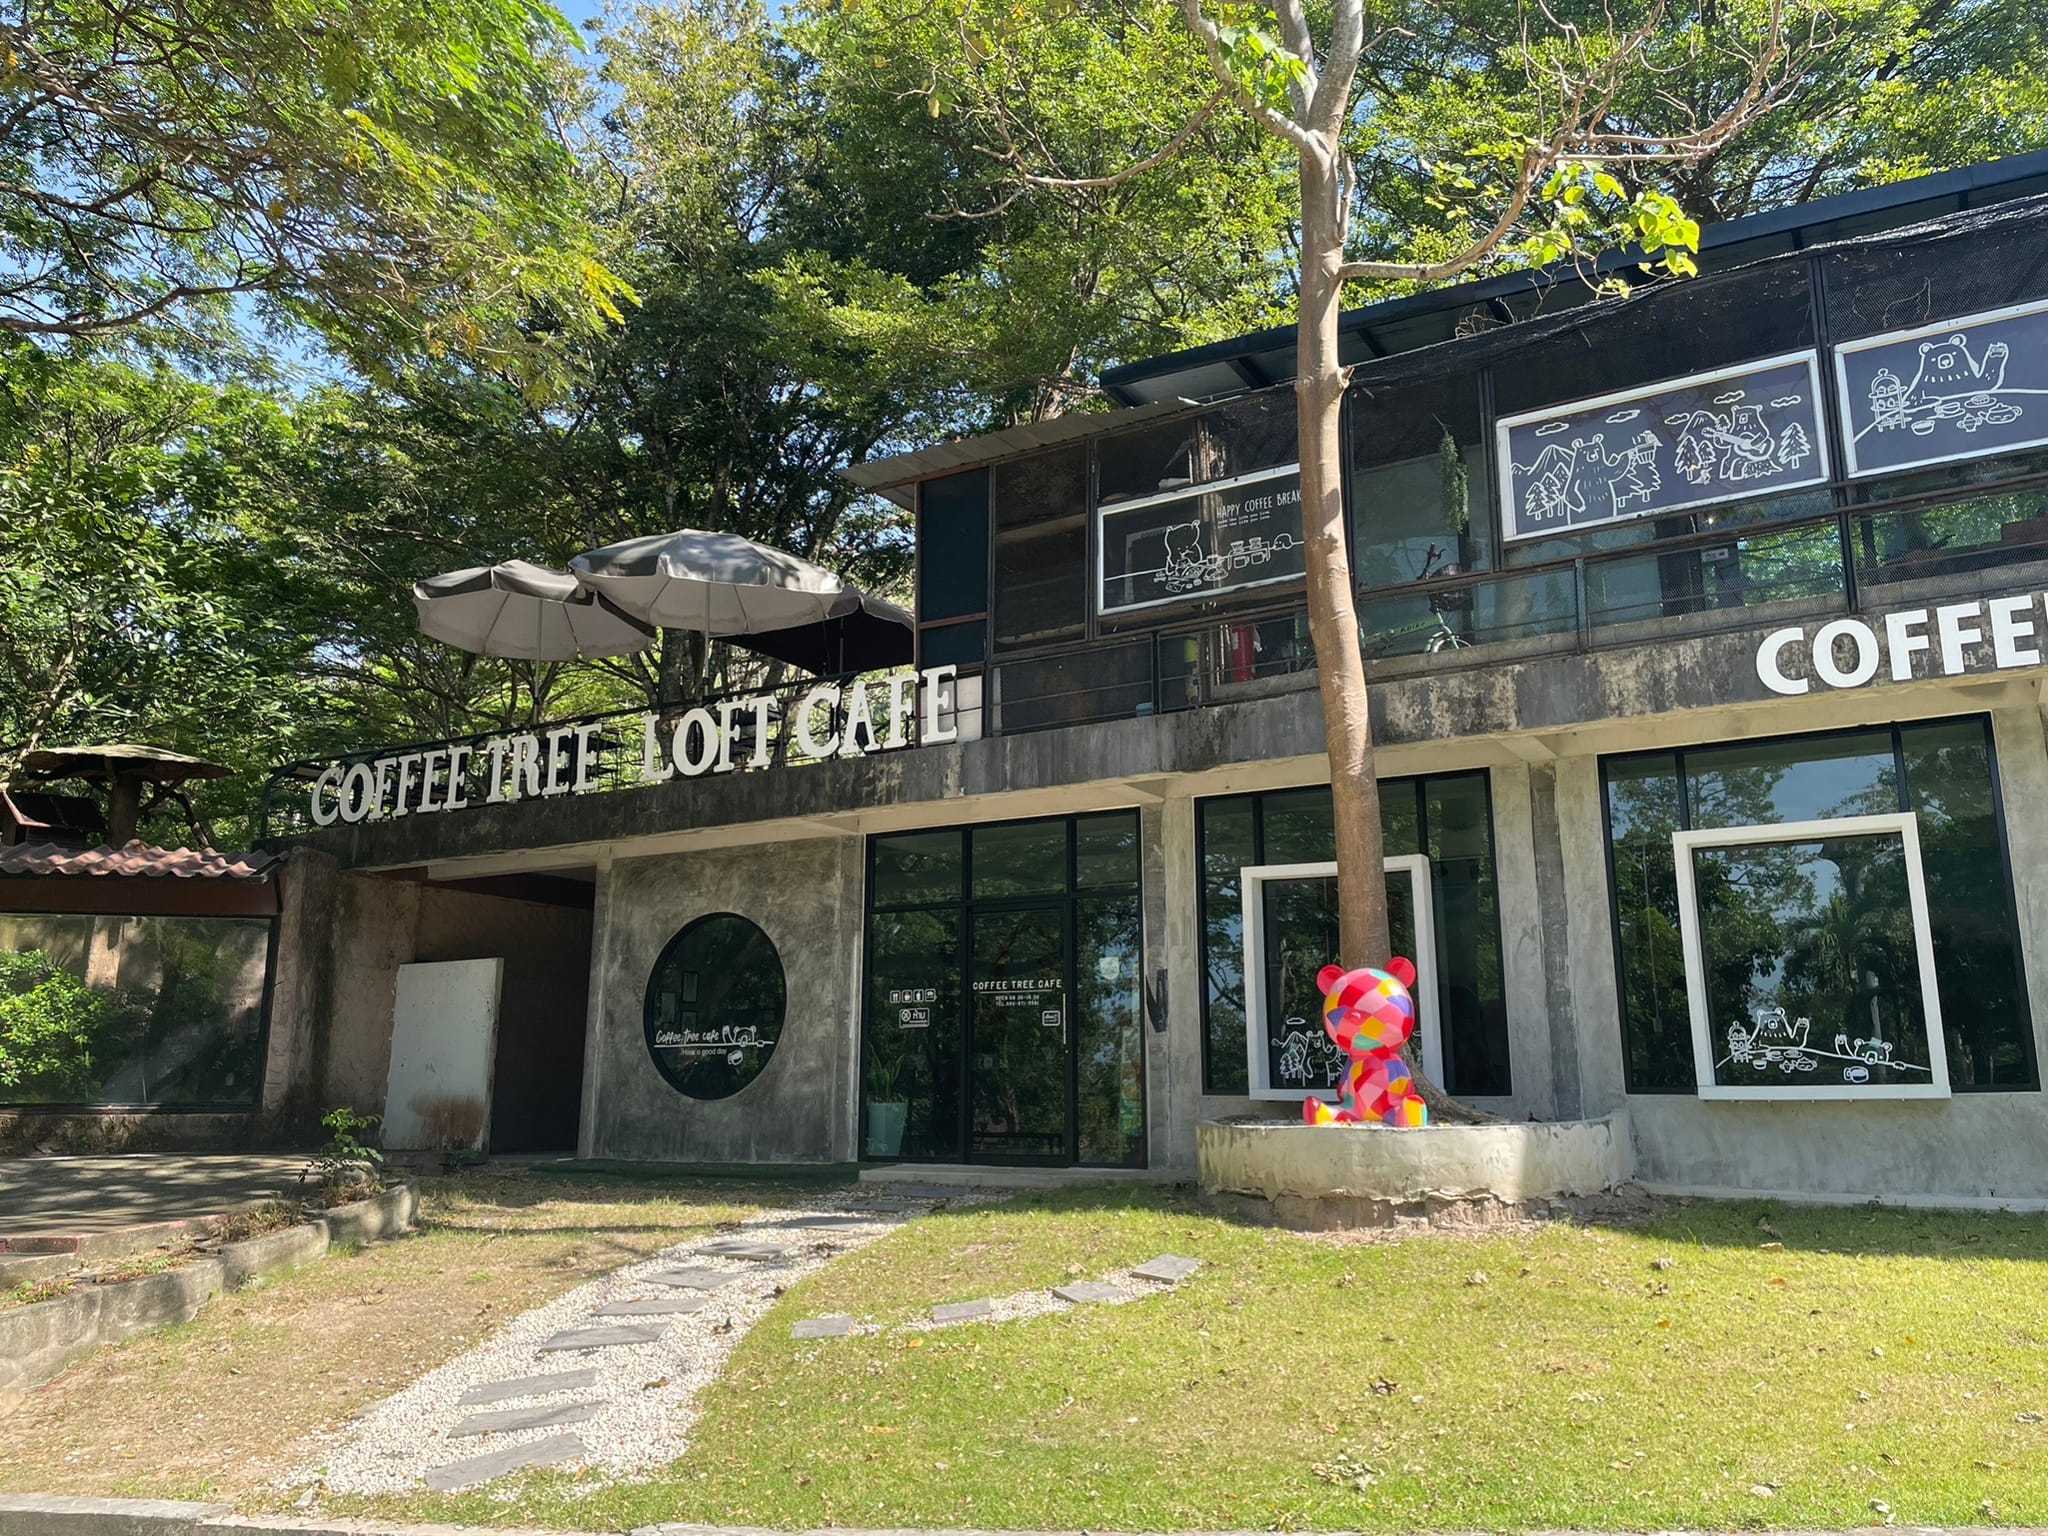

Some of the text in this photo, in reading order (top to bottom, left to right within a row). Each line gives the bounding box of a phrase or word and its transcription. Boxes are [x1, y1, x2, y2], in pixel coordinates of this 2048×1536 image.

[1216, 489, 1302, 518] HAPPY COFFEE BREAK
[1756, 593, 2048, 695] COFFE
[311, 664, 958, 827] COFFEE TREE LOFT CAFE
[972, 979, 1062, 990] COFFEE TREE CAFE
[655, 1030, 681, 1043] Coffee
[702, 1029, 719, 1042] cafe
[702, 1048, 716, 1057] good
[717, 1047, 728, 1056] day
